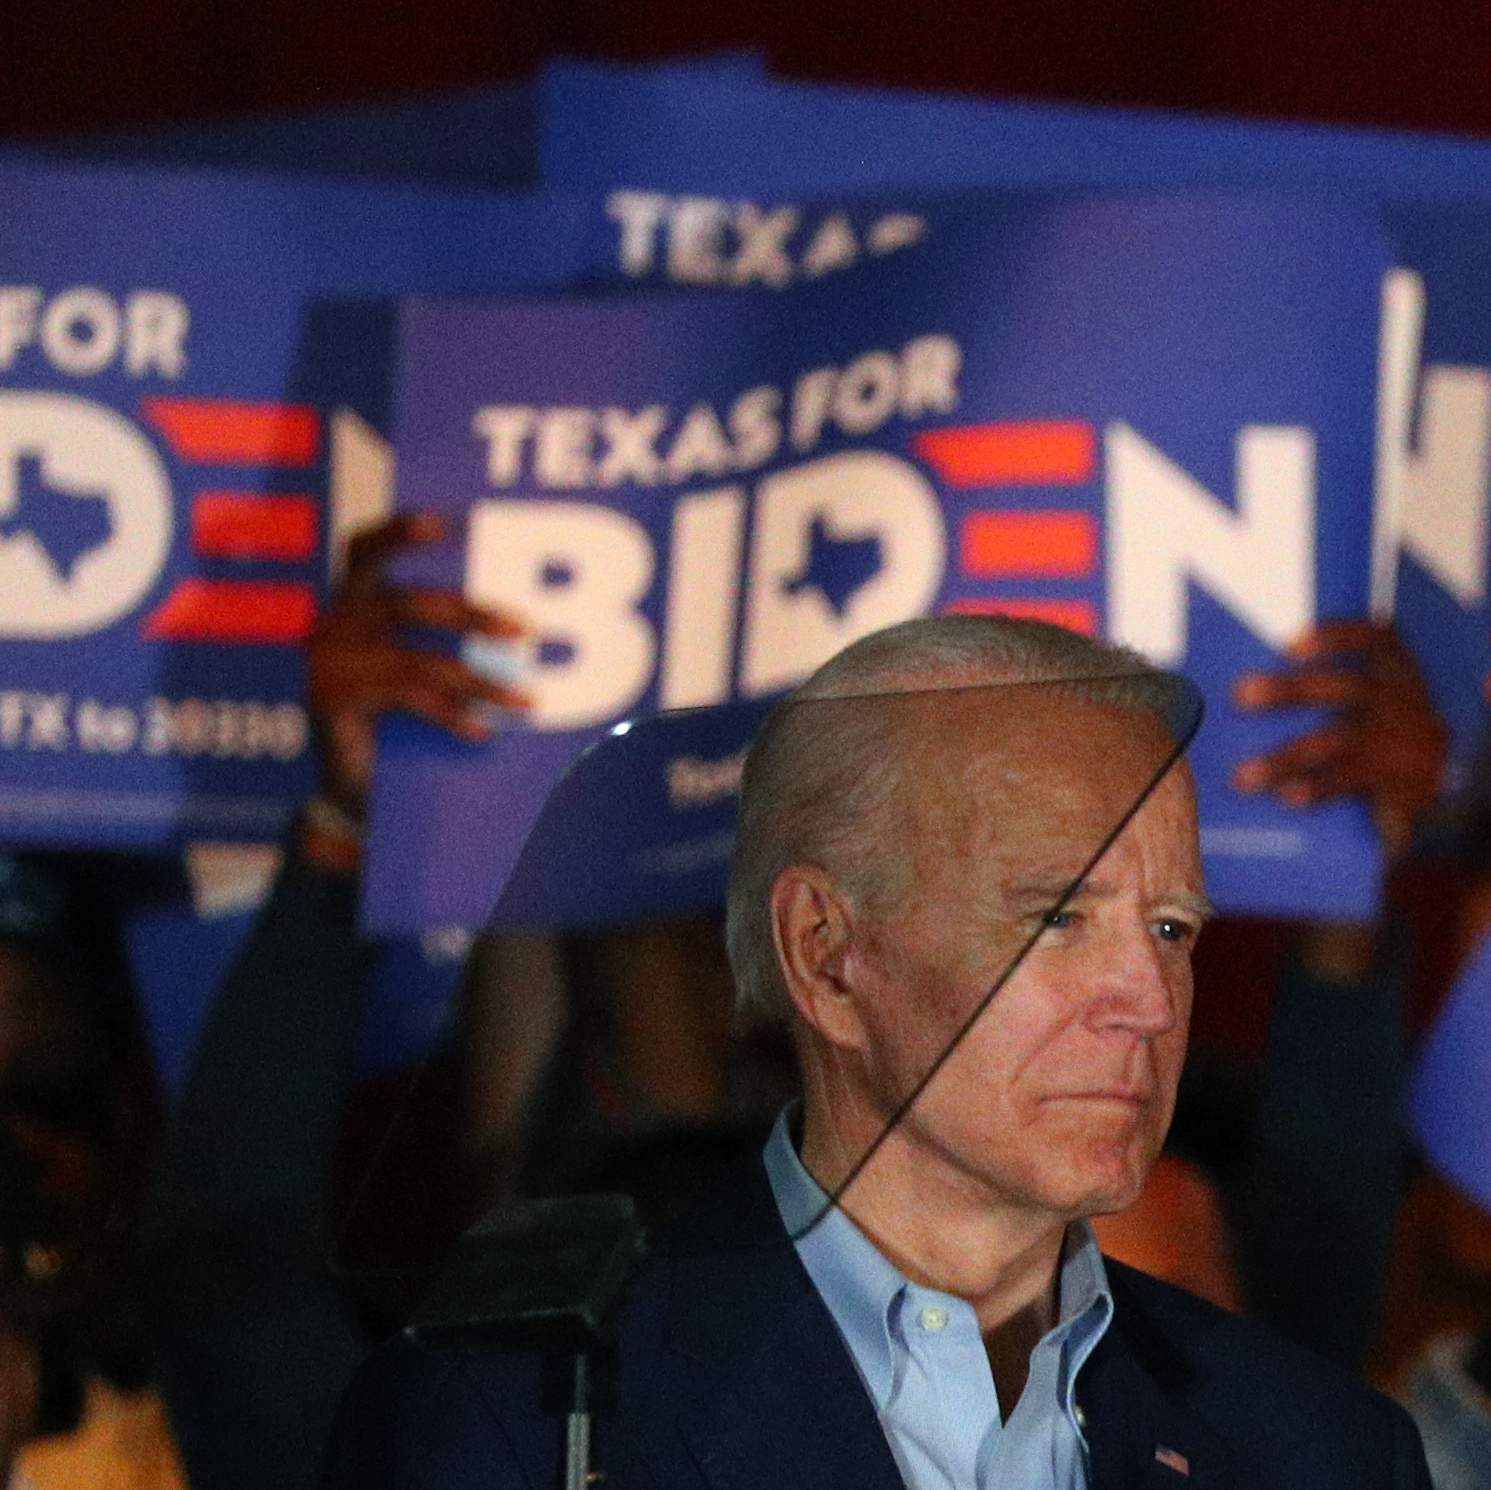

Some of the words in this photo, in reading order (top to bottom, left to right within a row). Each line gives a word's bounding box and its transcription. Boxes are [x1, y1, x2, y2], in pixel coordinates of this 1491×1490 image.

[0, 286, 191, 380] FOR
[473, 387, 782, 488] TEXAS
[790, 333, 962, 449] FOR
[463, 420, 1316, 731] BIDEN
